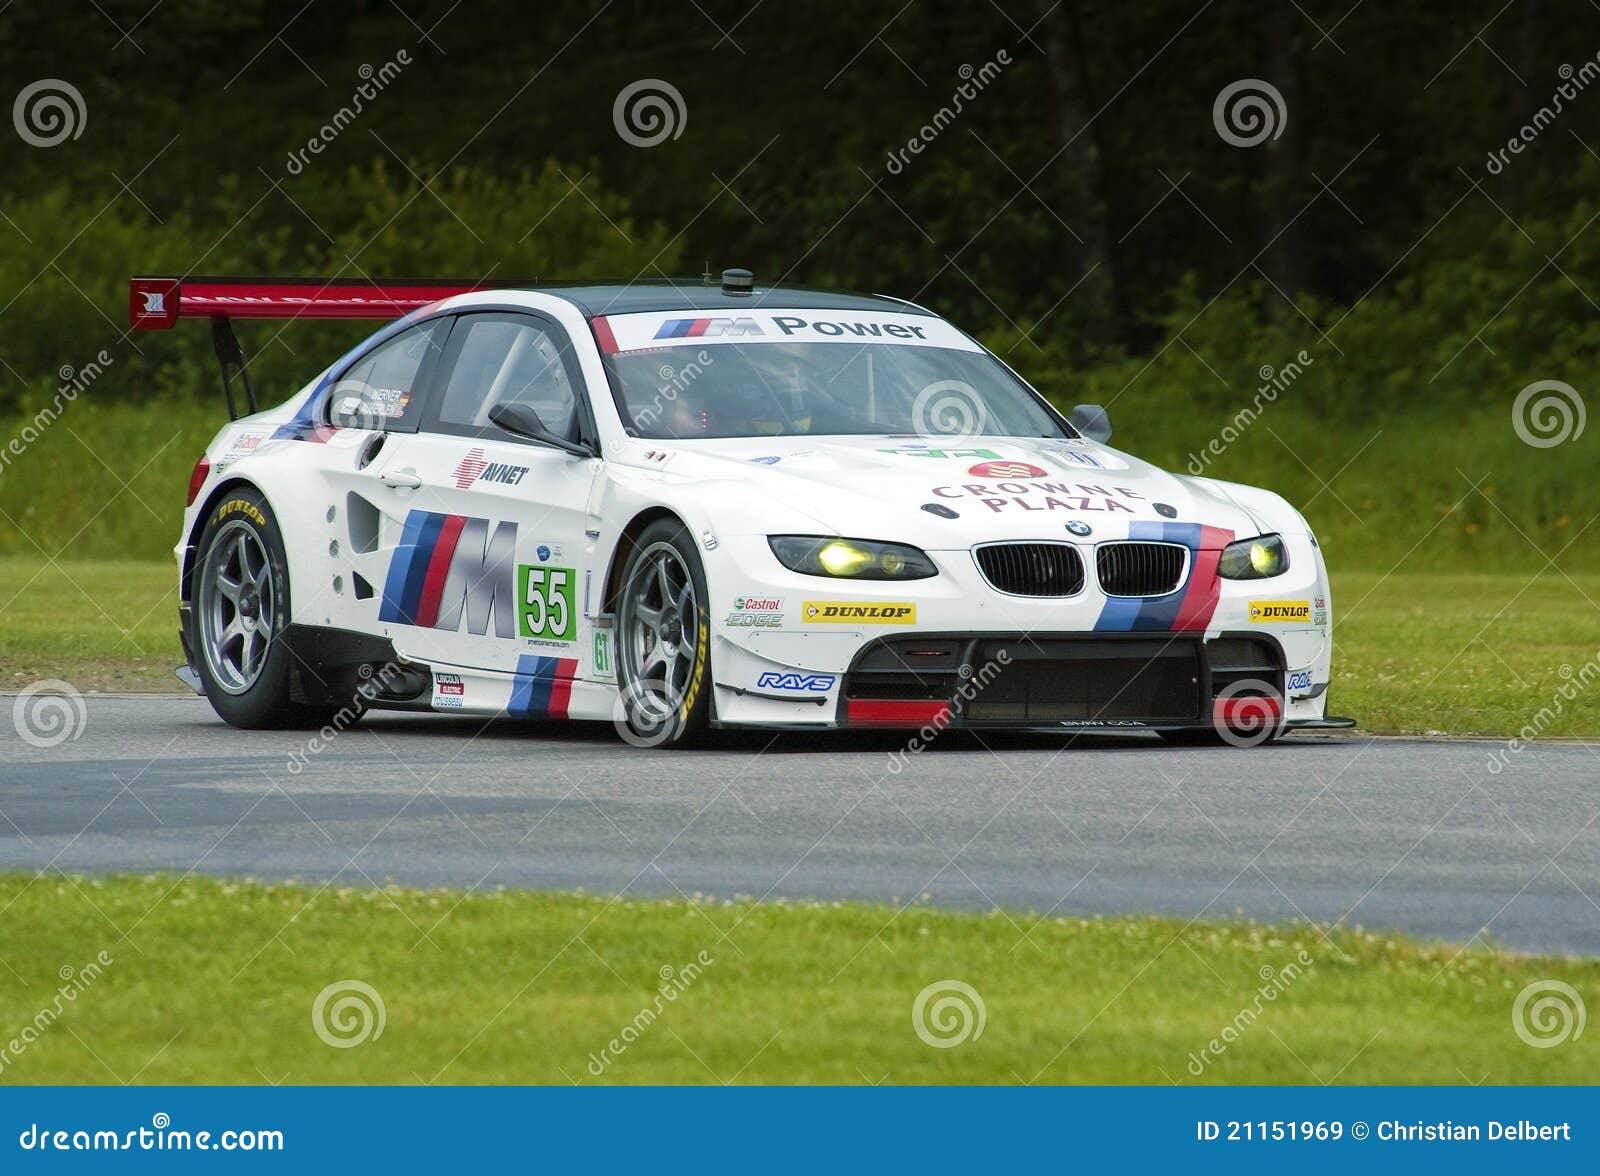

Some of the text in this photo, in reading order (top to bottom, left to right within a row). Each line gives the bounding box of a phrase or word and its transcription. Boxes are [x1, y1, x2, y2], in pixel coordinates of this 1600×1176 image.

[771, 316, 927, 339] Power
[480, 462, 529, 485] AVNET
[932, 482, 1146, 500] CROWNE
[981, 496, 1135, 513] PLAZA
[526, 567, 568, 638] 55
[745, 598, 780, 610] Castrol
[726, 612, 784, 628] EDGE
[822, 606, 912, 618] DUNLOP
[1262, 606, 1309, 617] DUNLOP
[757, 671, 836, 691] RAYS
